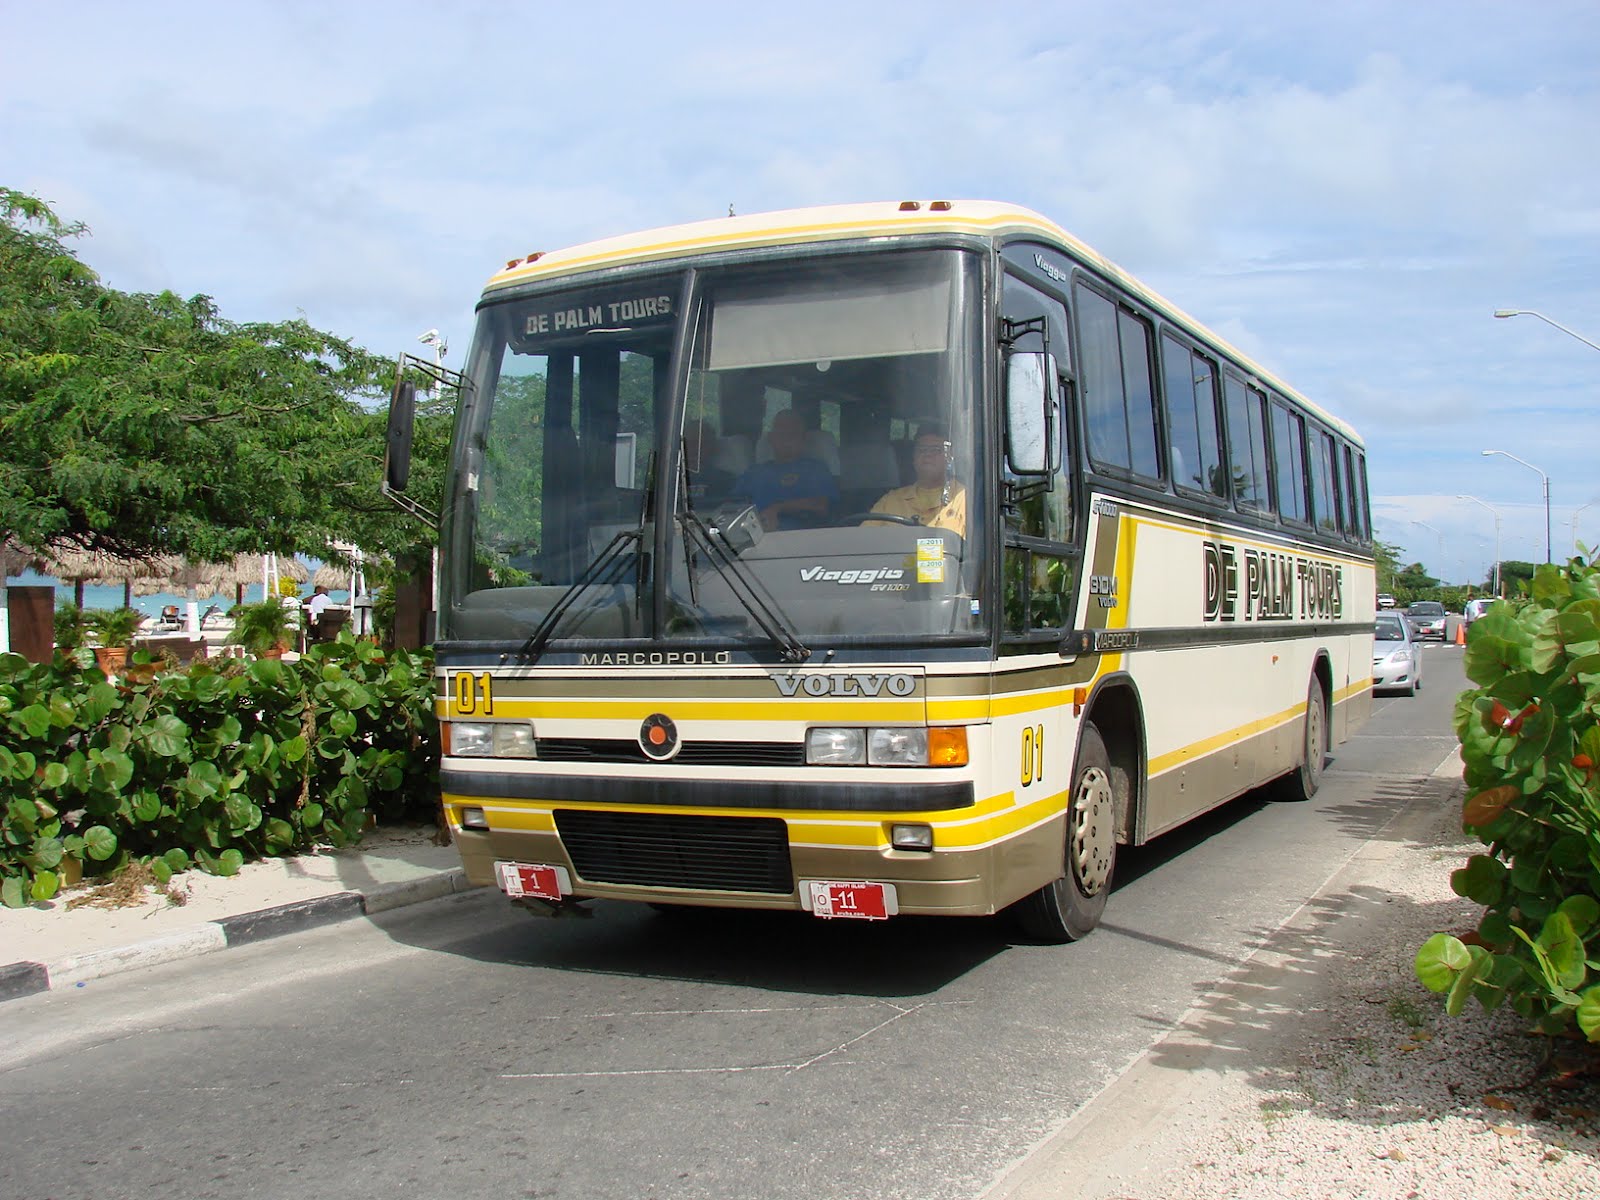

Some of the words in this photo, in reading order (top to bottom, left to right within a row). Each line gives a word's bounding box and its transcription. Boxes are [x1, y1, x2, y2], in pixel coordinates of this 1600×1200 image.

[1033, 253, 1066, 282] Viaggio
[526, 314, 549, 335] DE
[554, 305, 603, 331] PALM
[608, 296, 672, 322] TOURS
[800, 566, 905, 584] Viaggio
[1203, 541, 1237, 622] DE
[1244, 549, 1293, 621] PALM
[1297, 558, 1342, 619] TOURS
[580, 651, 731, 665] MARCOPOLO
[456, 671, 493, 716] 01
[770, 673, 917, 697] VOLVO
[1021, 724, 1043, 787] 01
